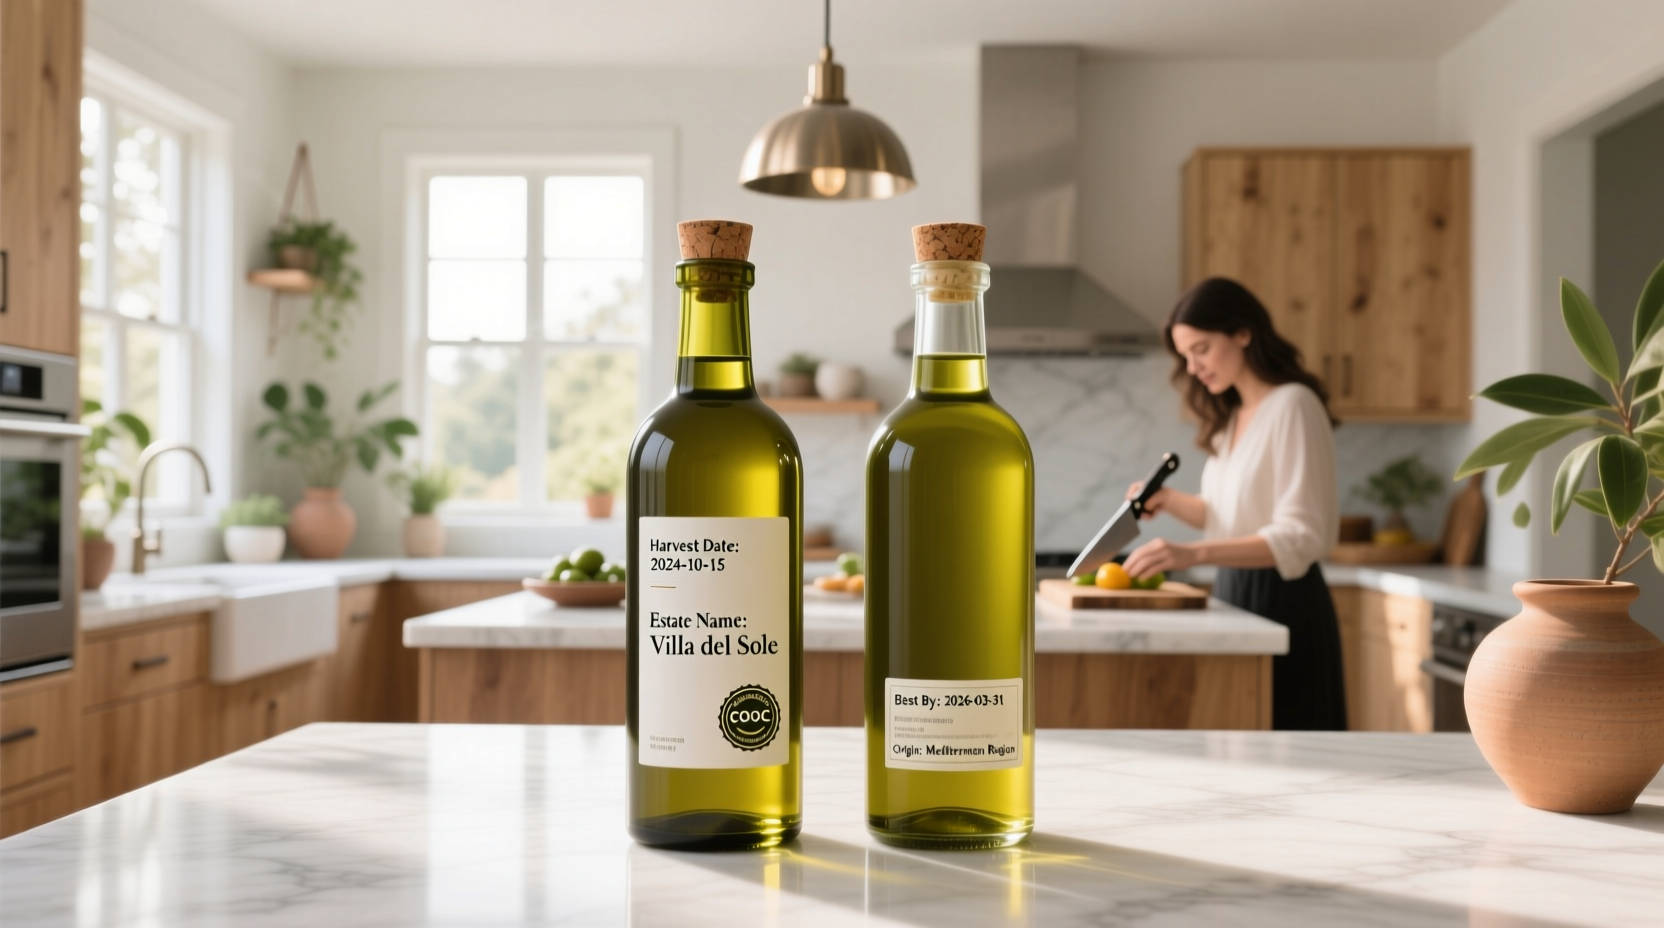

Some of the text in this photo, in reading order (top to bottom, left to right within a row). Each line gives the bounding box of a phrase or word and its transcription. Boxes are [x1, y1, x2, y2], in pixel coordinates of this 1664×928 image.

[650, 538, 739, 553] Harvest Date:
[650, 558, 725, 571] 2024-10-15
[649, 611, 747, 629] Estate Name:
[650, 634, 779, 656] Villa del Sole
[894, 694, 1004, 711] Best By: 2026-03-31
